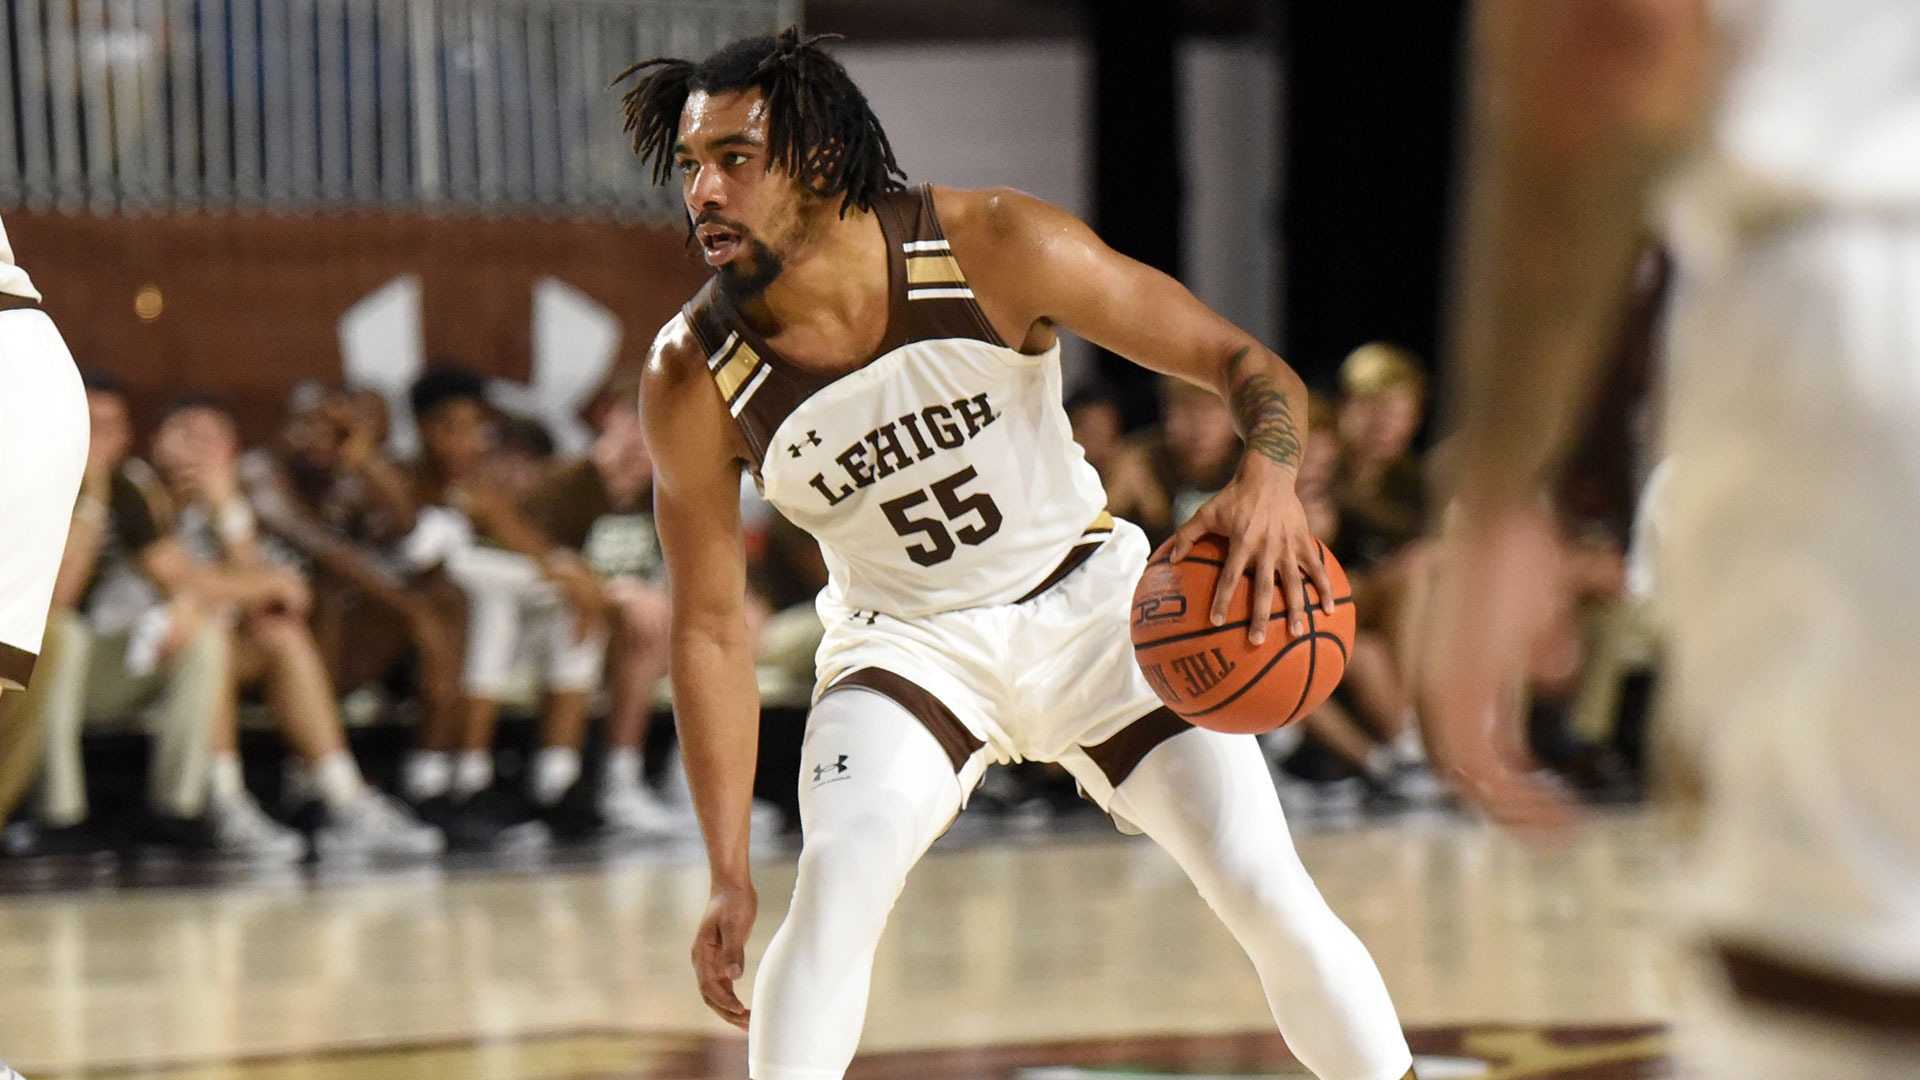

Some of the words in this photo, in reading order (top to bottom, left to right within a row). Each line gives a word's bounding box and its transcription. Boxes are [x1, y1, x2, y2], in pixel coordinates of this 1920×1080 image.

[809, 392, 1001, 506] LEHIGH
[879, 465, 1003, 567] 55
[1171, 648, 1236, 697] THE
